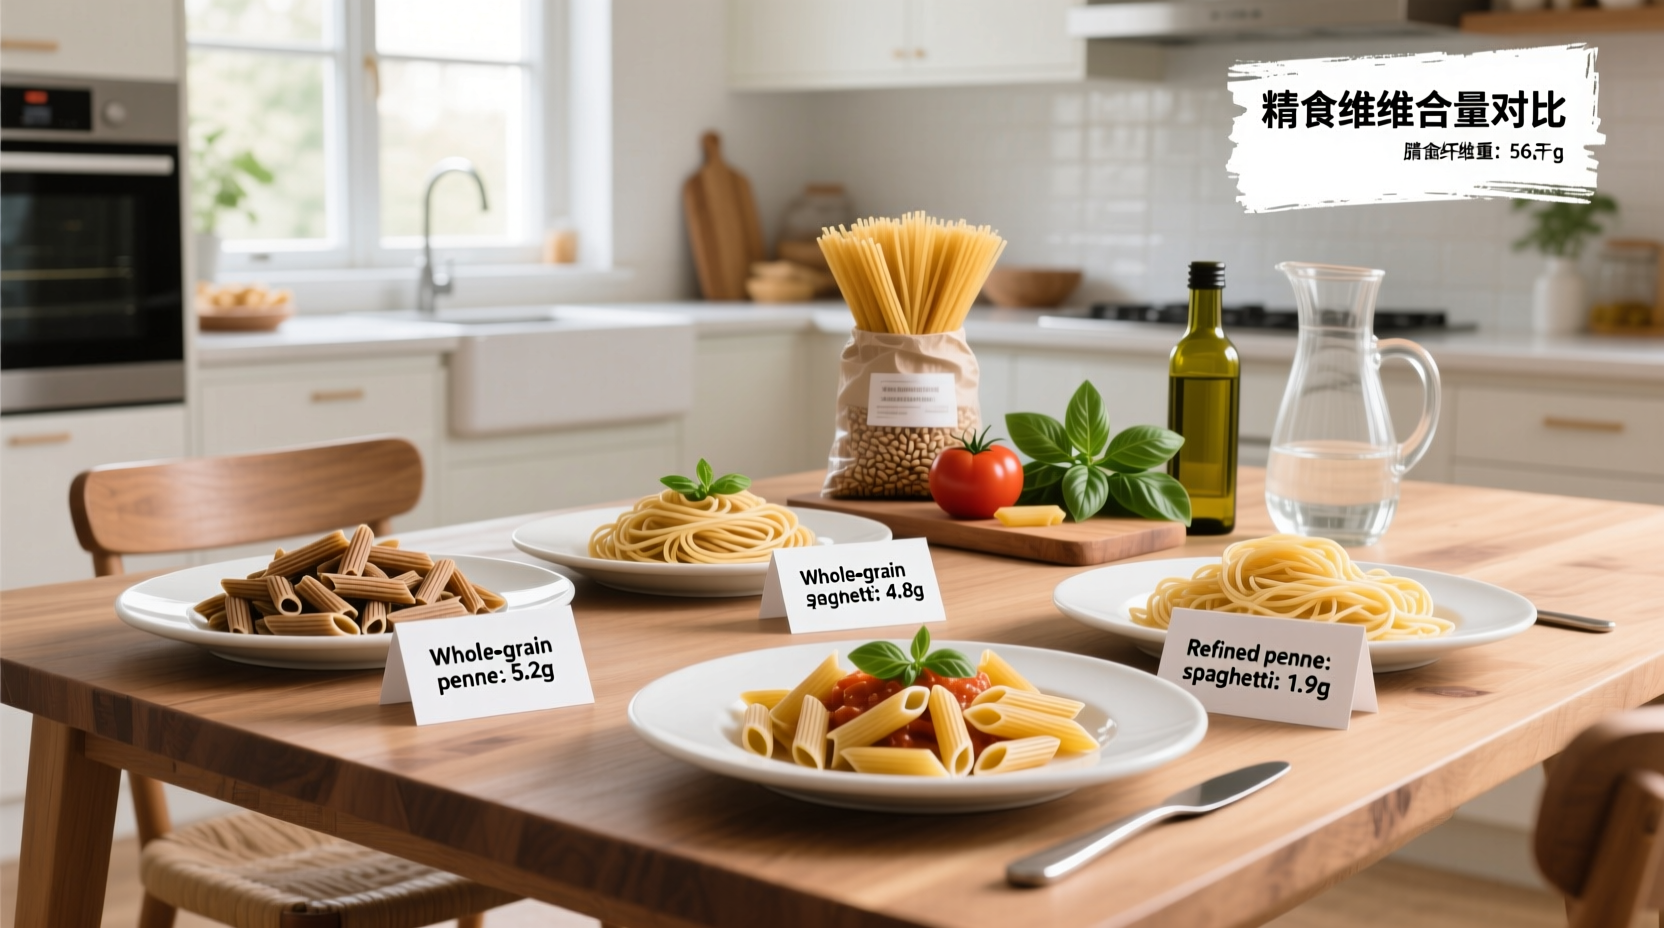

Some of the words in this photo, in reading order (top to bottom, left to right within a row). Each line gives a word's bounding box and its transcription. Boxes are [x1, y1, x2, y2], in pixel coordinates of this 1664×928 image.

[799, 561, 906, 586] Whole-grain
[885, 581, 925, 602] 4.8g
[428, 636, 553, 666] Whole-grain
[1186, 638, 1261, 663] Refined
[1263, 650, 1331, 671] penne:
[437, 669, 507, 696] penne:
[511, 660, 555, 683] 5.2g
[1182, 666, 1280, 690] spaghetti:
[1287, 673, 1331, 701] 1.9g
